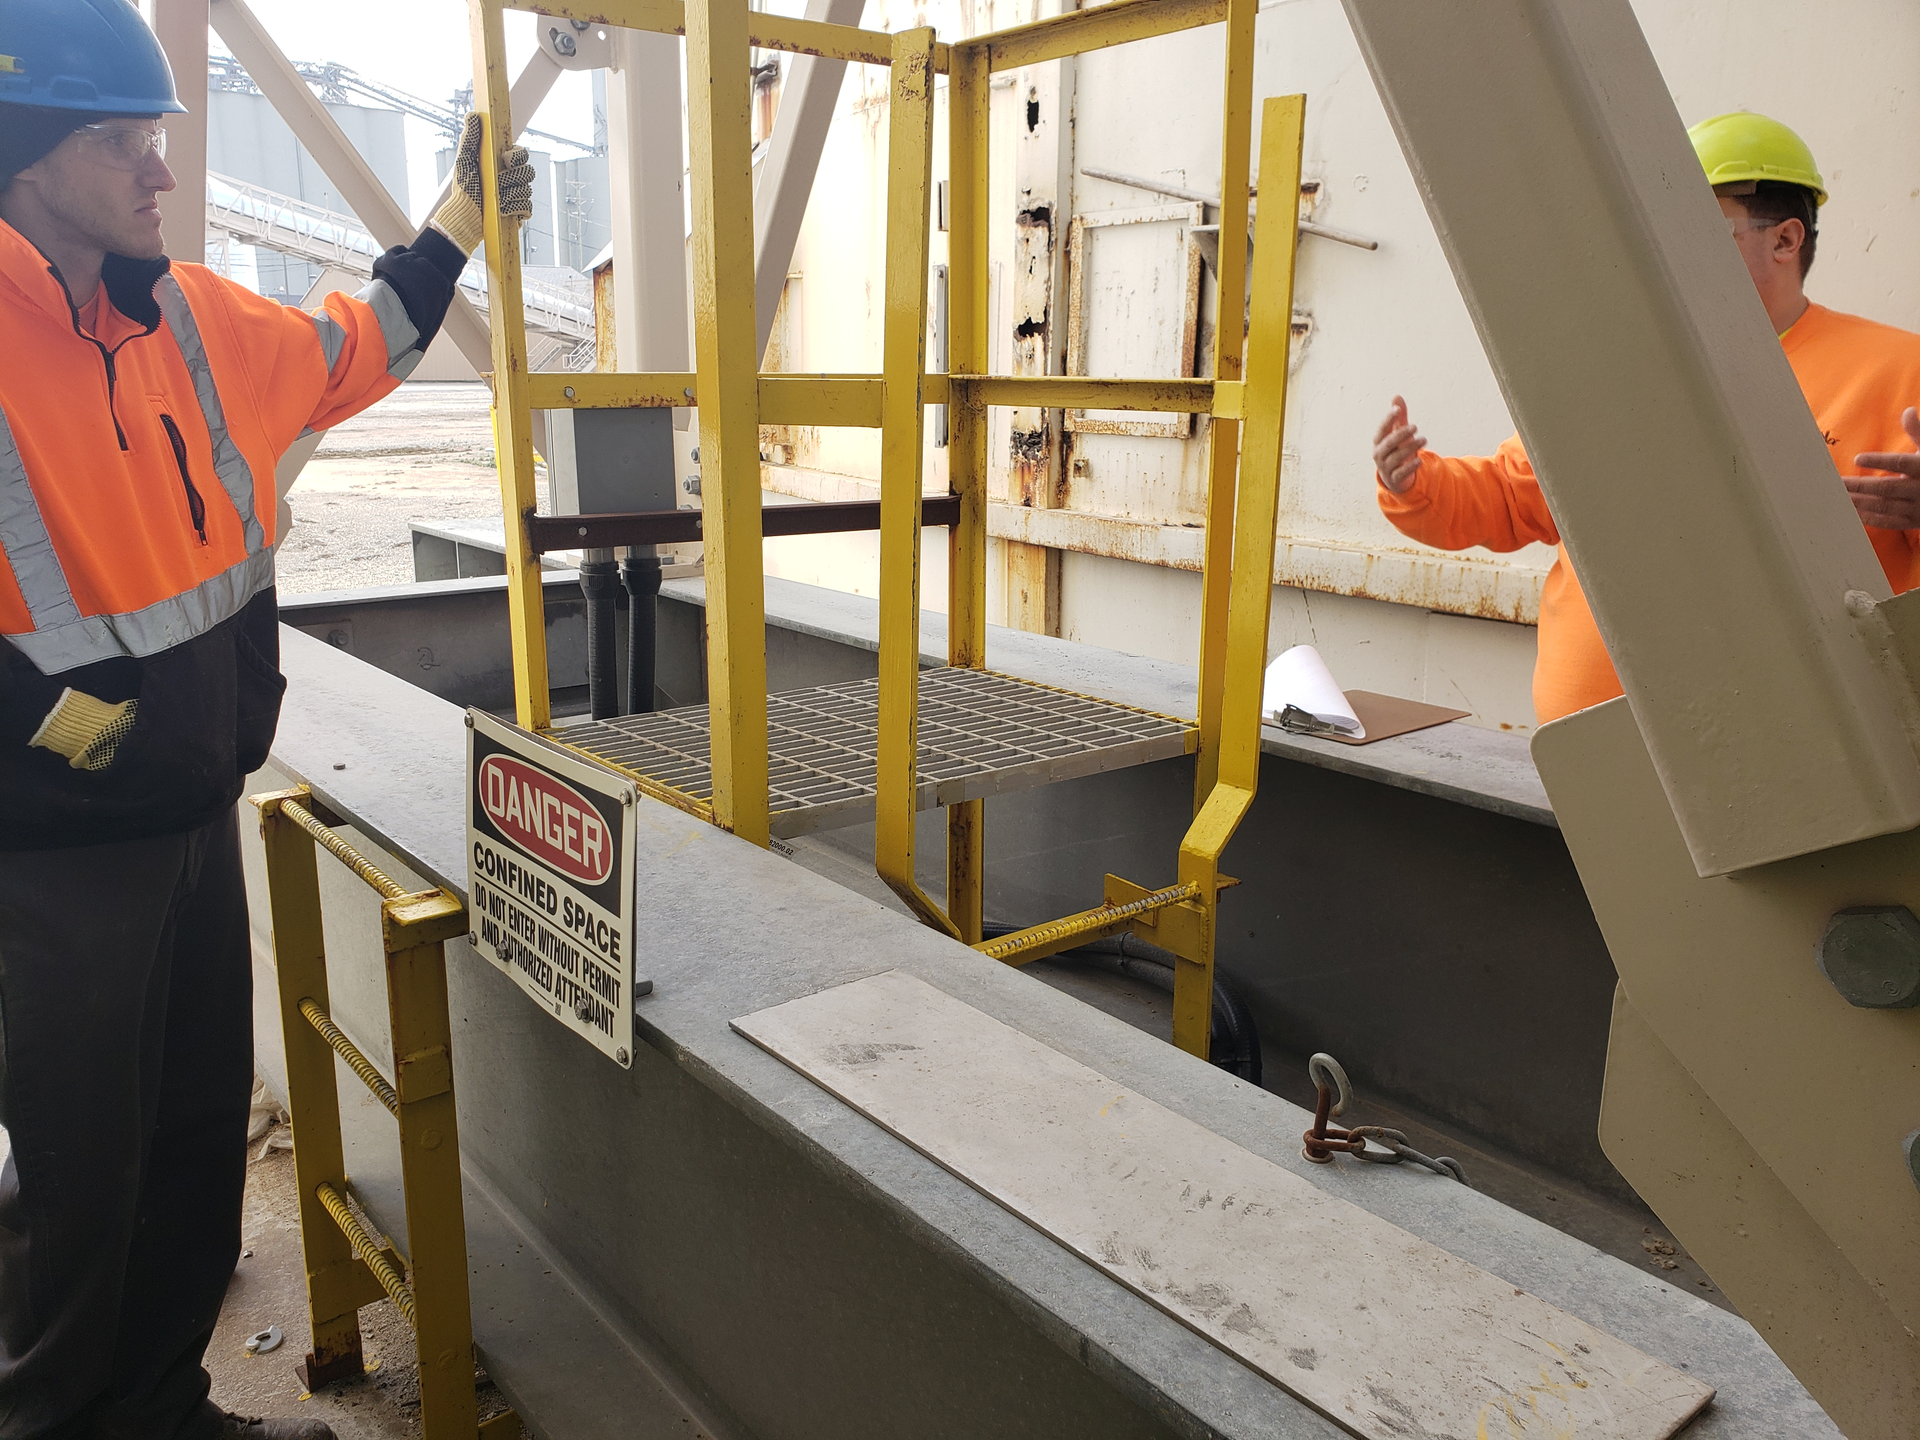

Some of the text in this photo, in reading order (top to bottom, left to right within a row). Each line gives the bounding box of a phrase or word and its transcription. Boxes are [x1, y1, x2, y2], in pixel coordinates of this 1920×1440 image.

[487, 762, 603, 876] DANGER
[473, 841, 621, 963] CONFINED SPACE
[475, 881, 487, 911] DO
[489, 890, 506, 924] NOT
[509, 903, 536, 947] ENTER
[538, 923, 580, 979] WITHOUT
[583, 955, 621, 1009] PERMIT
[482, 915, 500, 948] AND
